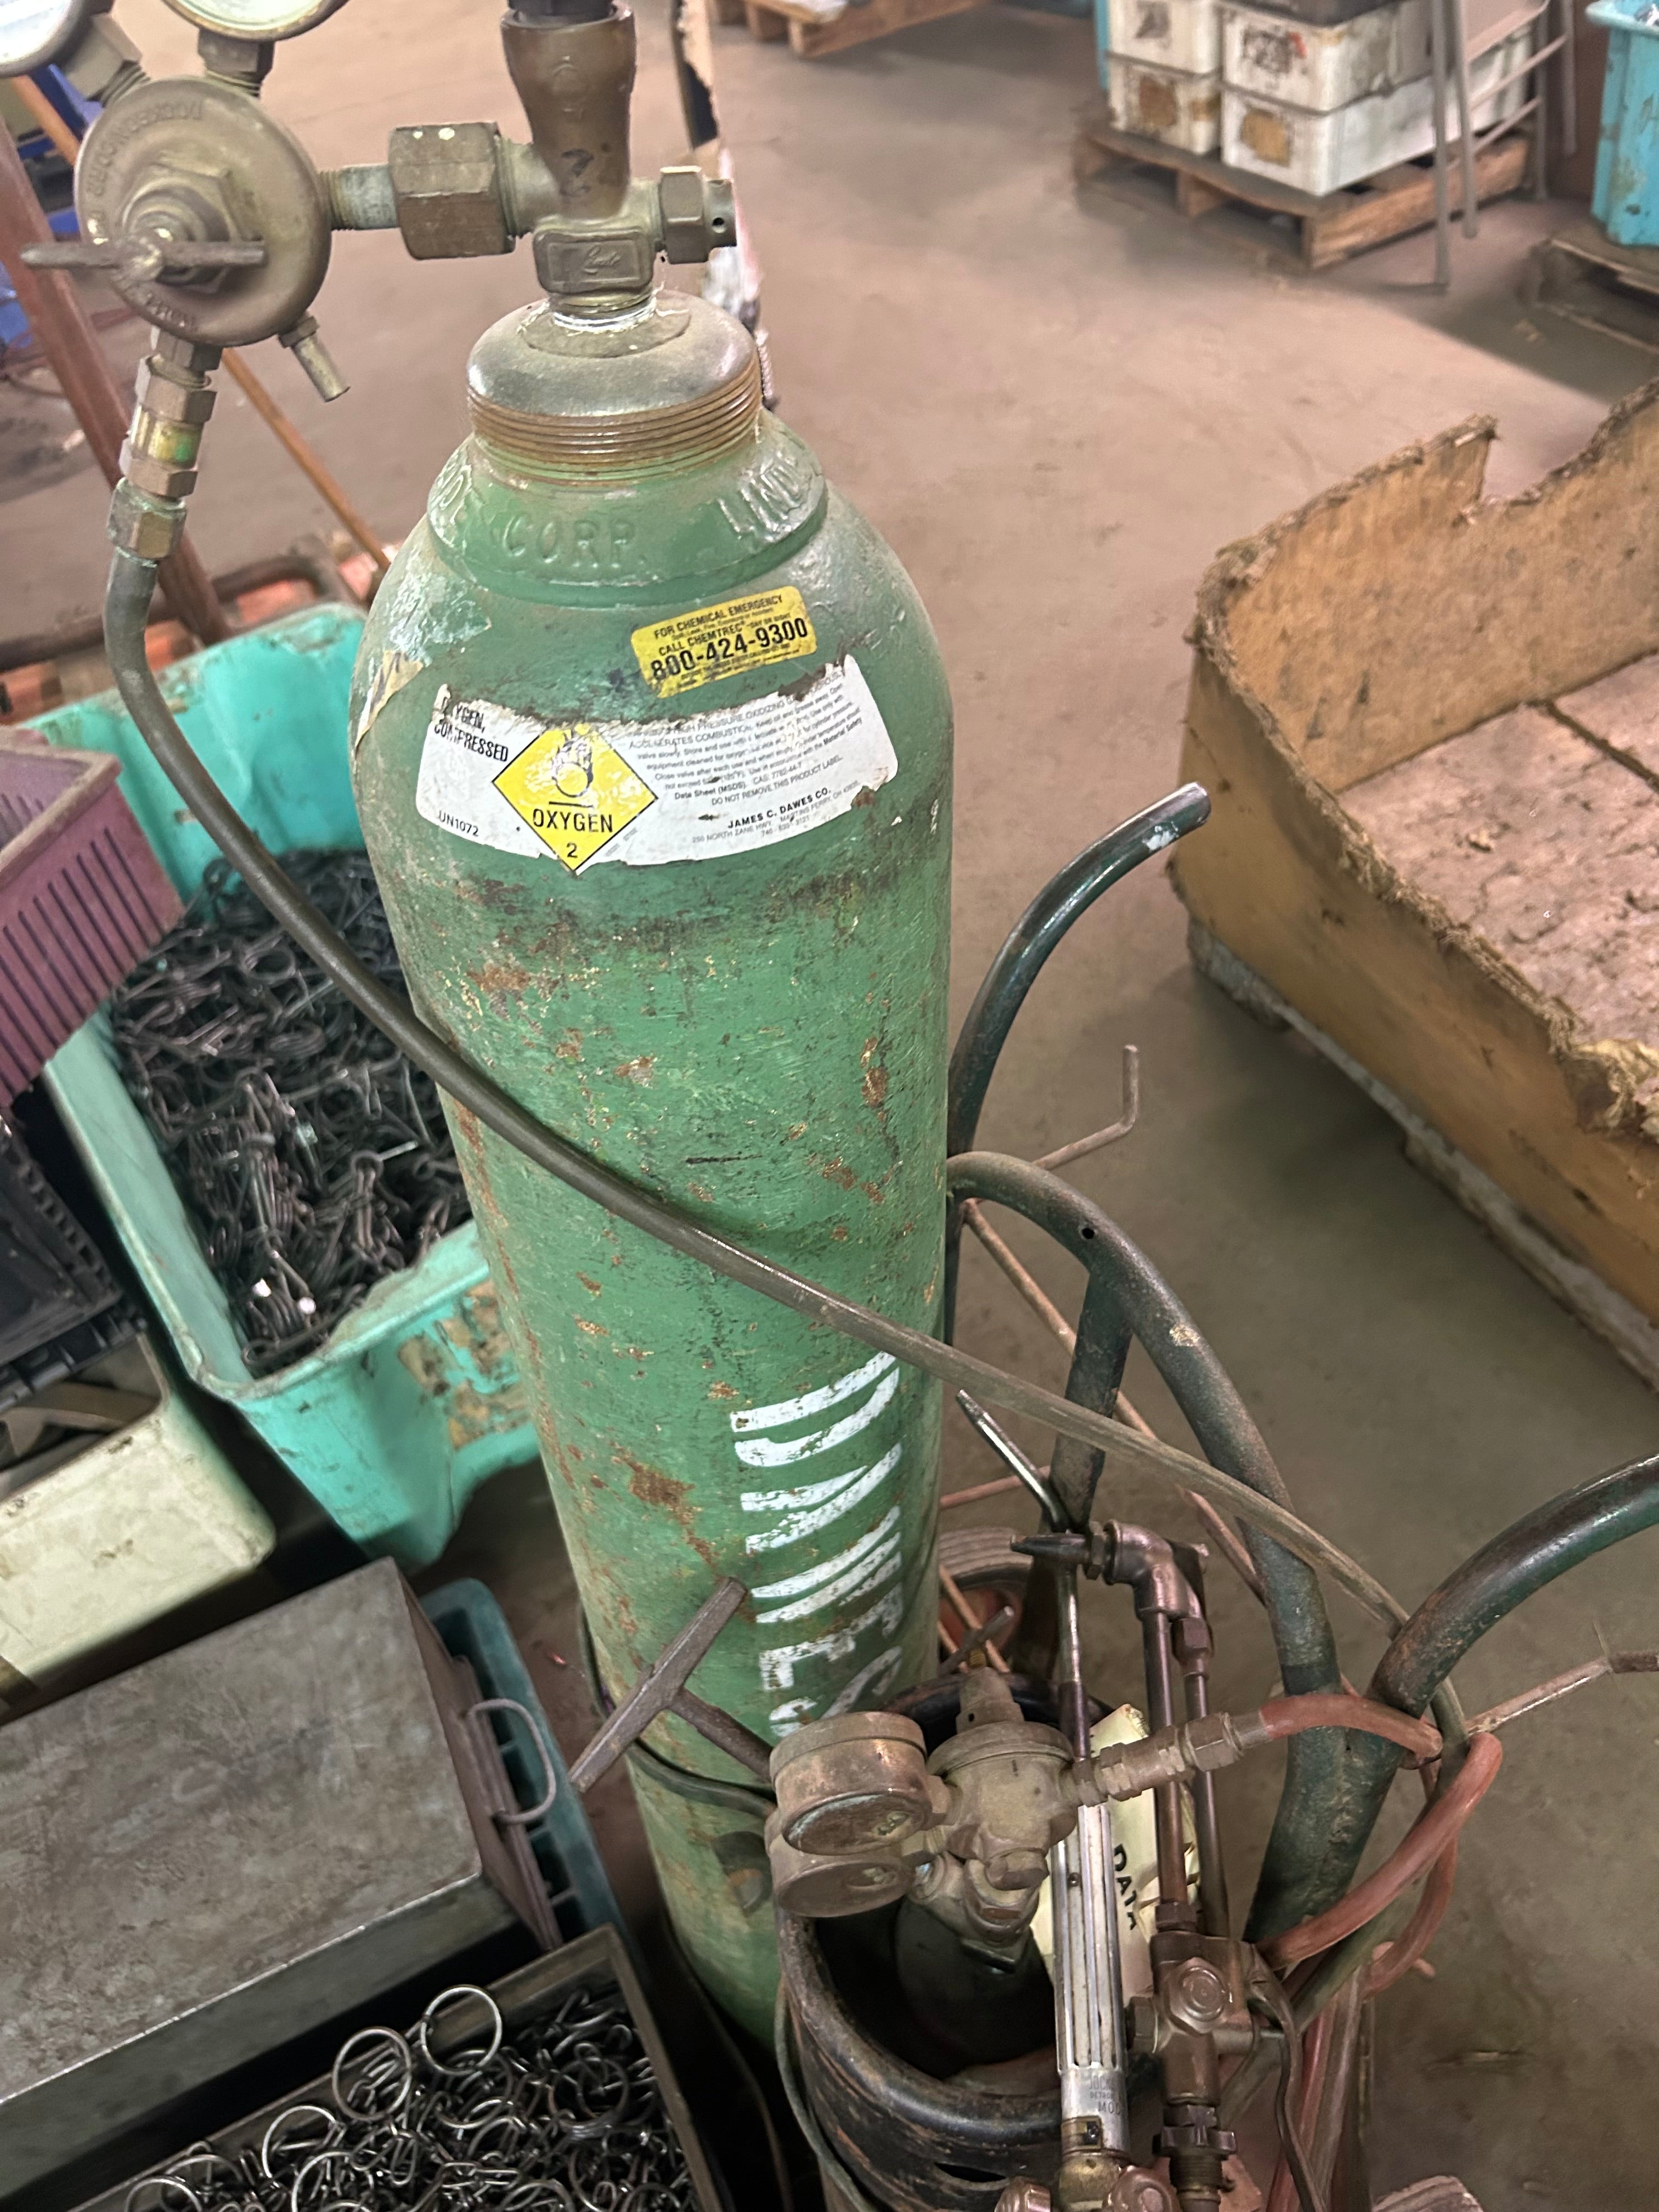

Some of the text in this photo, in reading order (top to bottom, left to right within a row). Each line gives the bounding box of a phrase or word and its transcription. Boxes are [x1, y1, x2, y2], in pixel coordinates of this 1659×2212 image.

[654, 595, 782, 639] FOR CHEMICAL EMERGENCY
[651, 618, 808, 680] 800-424-9300
[659, 642, 685, 656] CALL
[533, 808, 613, 833] OXYGEN
[729, 814, 763, 828] JAMES
[780, 795, 812, 814] DAWES
[815, 788, 831, 799] CO.
[438, 809, 479, 838] UN1072
[566, 842, 579, 859] 2
